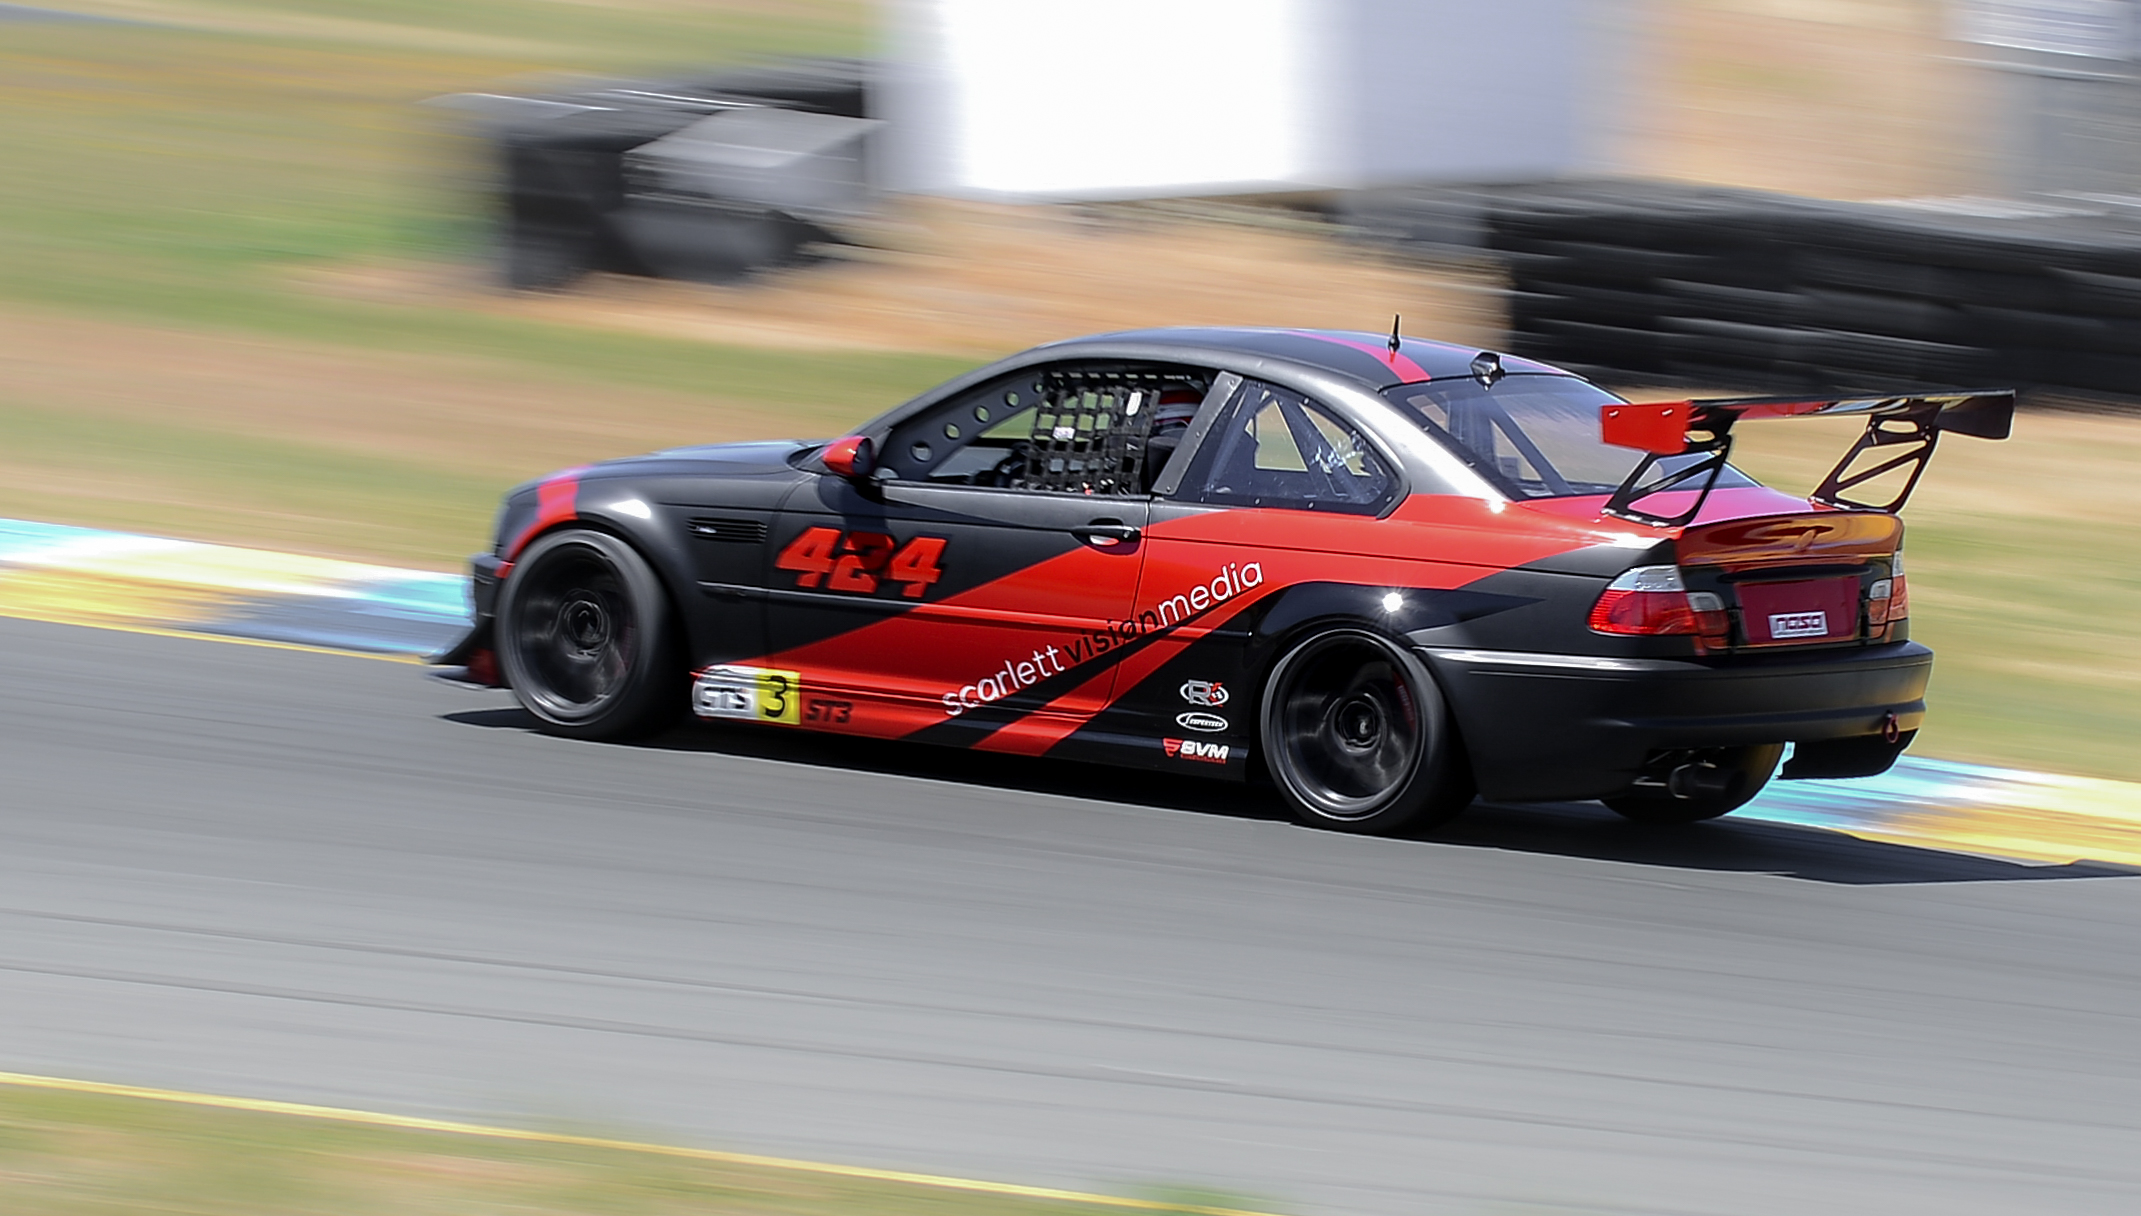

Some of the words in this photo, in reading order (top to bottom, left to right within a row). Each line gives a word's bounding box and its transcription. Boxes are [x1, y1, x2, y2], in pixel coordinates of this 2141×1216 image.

[774, 526, 948, 598] 424
[764, 675, 788, 718] 3
[942, 645, 1065, 716] scarlett
[804, 698, 854, 724] ST3
